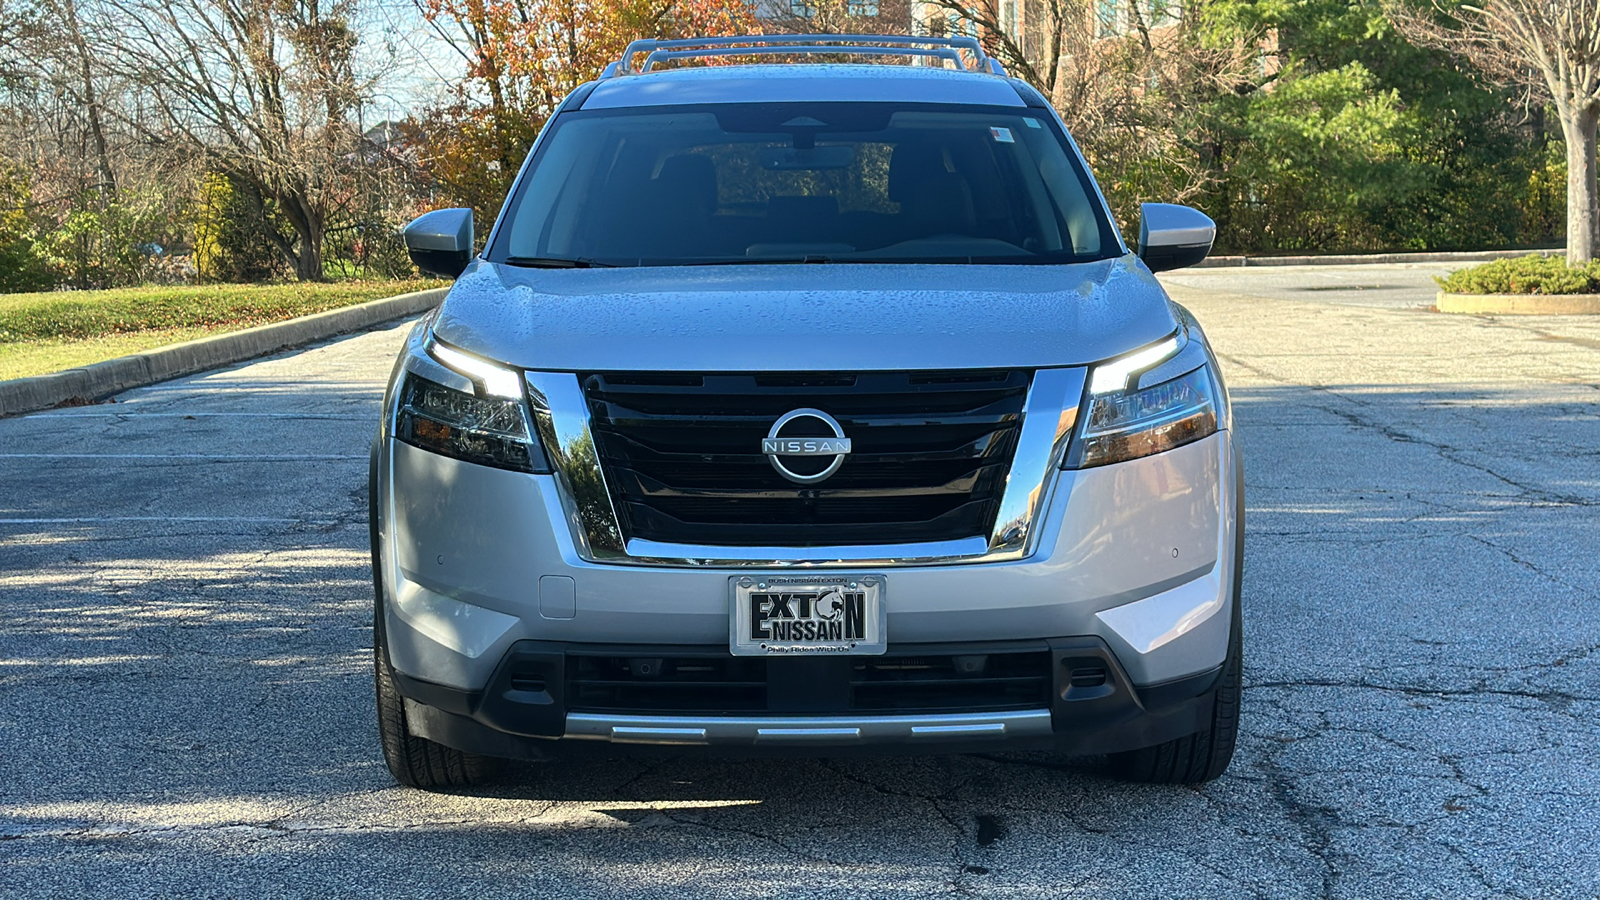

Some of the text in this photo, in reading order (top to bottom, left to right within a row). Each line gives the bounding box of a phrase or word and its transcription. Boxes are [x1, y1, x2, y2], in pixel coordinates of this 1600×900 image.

[764, 441, 848, 452] NISSAN
[750, 592, 865, 640] EXTON
[772, 621, 842, 641] NISSAN
